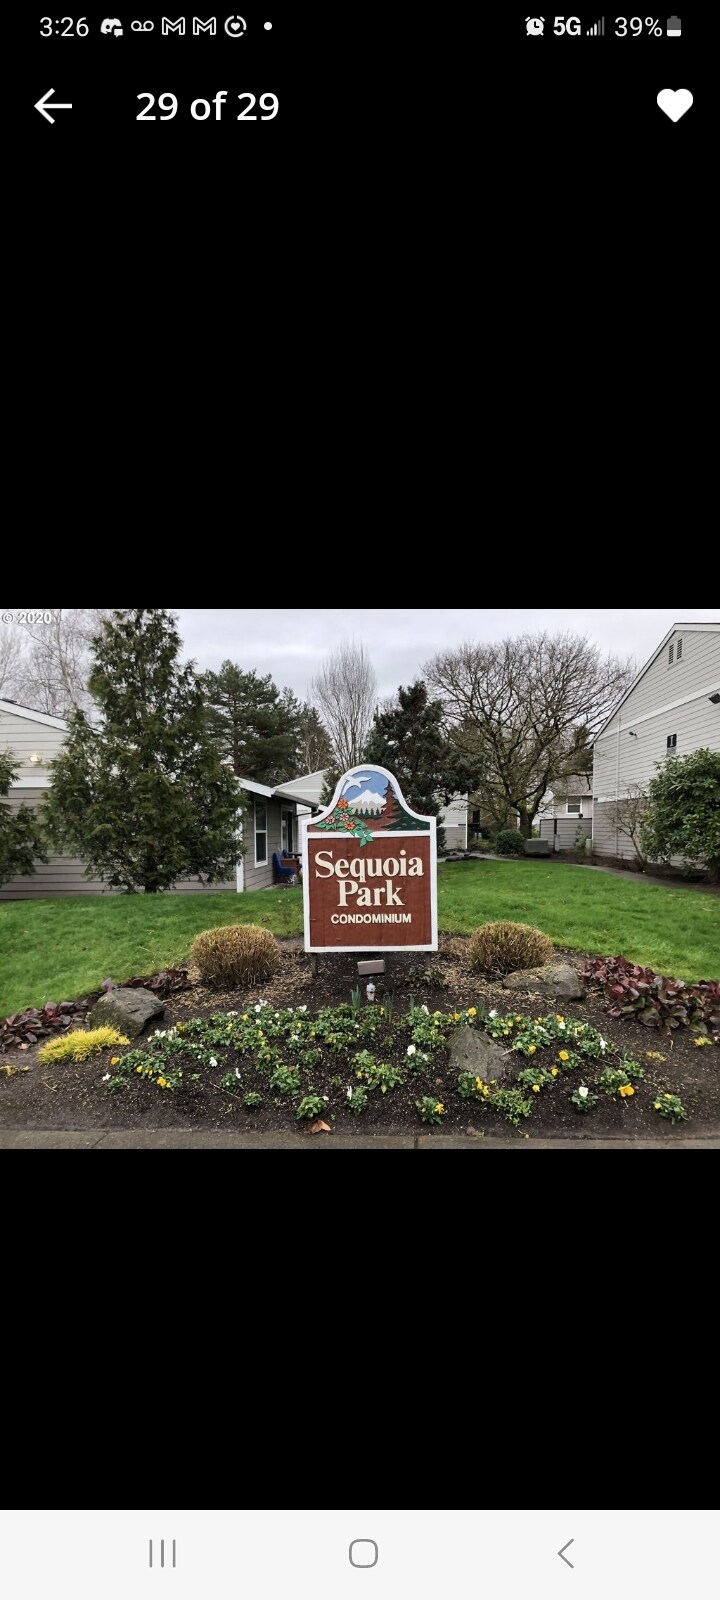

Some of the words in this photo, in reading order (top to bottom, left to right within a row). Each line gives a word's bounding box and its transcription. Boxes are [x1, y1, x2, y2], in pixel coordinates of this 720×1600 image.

[39, 17, 89, 36] 3:26
[553, 17, 581, 35] 5G
[614, 17, 662, 36] 39%
[136, 93, 178, 120] 29
[191, 91, 228, 120] of
[237, 93, 279, 120] 29
[315, 850, 424, 882] Sequoia
[336, 881, 405, 907] Park
[331, 913, 412, 925] CONDOMINIUM
